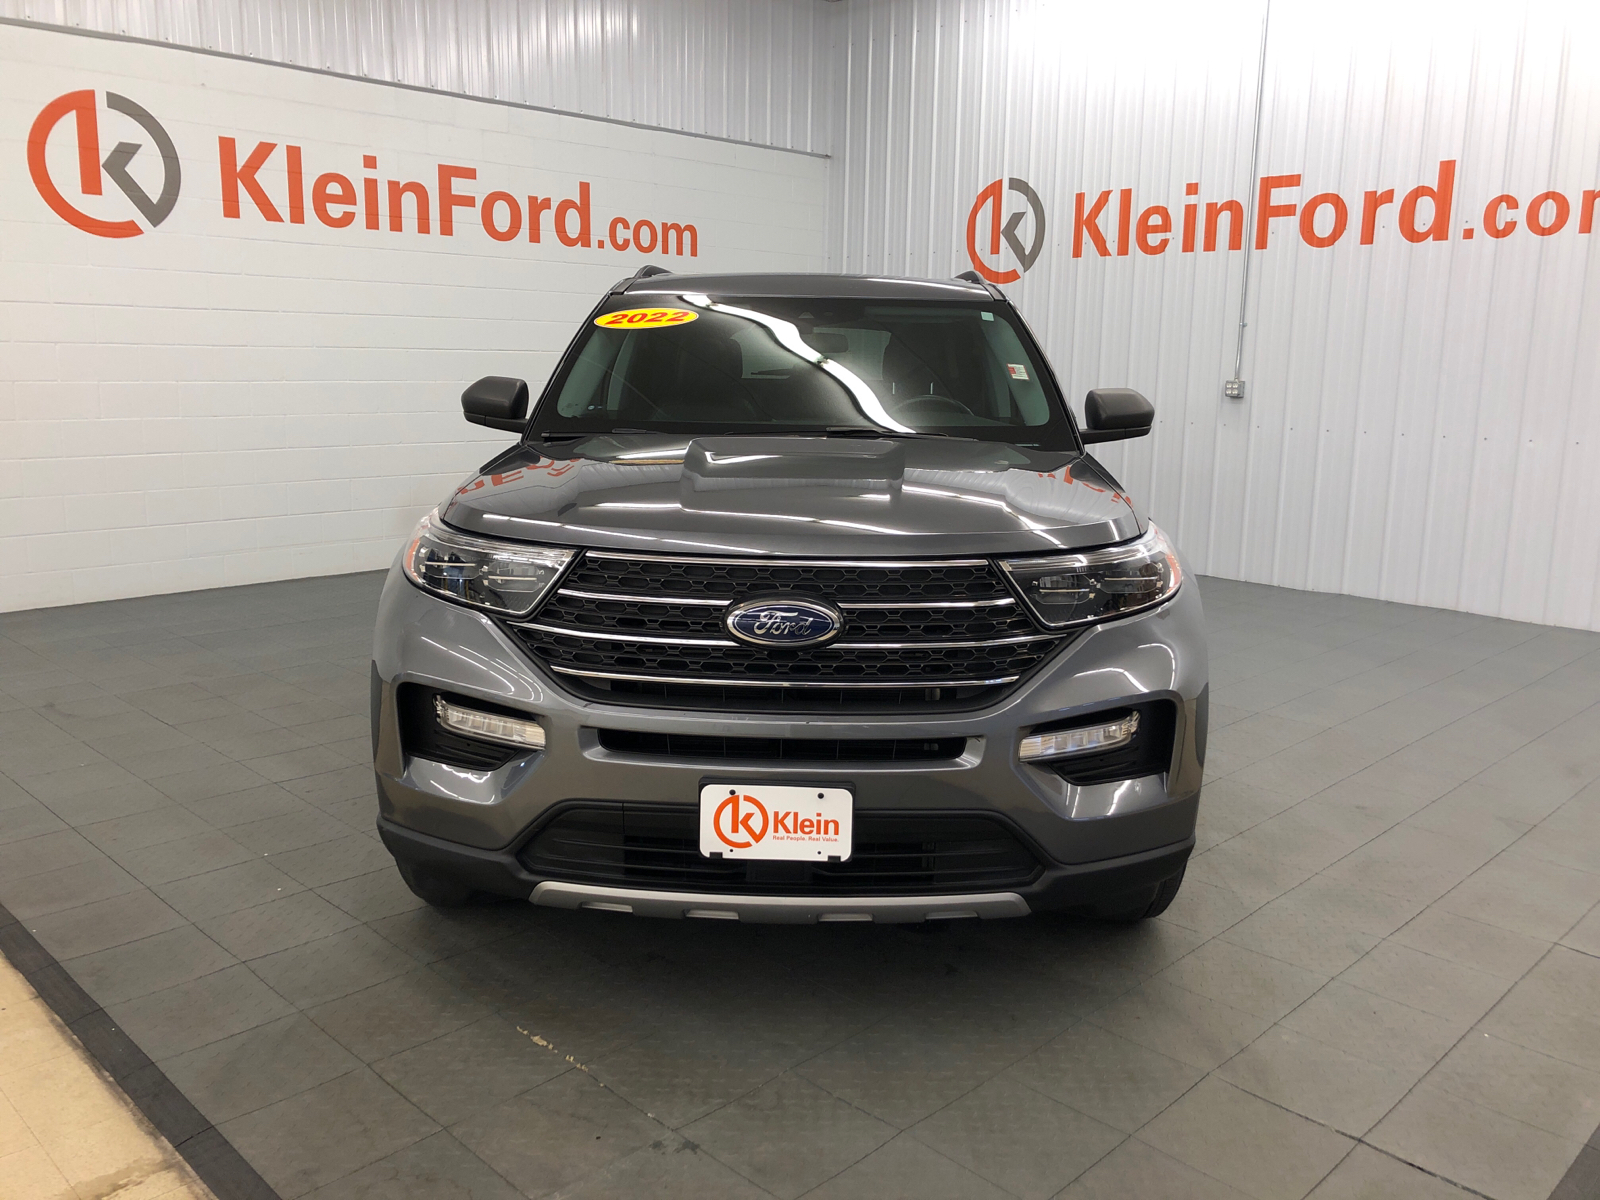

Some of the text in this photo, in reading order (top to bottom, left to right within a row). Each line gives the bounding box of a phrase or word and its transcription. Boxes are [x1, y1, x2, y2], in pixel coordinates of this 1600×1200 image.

[218, 136, 698, 258] KleinFord.com
[604, 311, 690, 325] 2022
[753, 610, 814, 635] Ford
[773, 811, 840, 836] Klein
